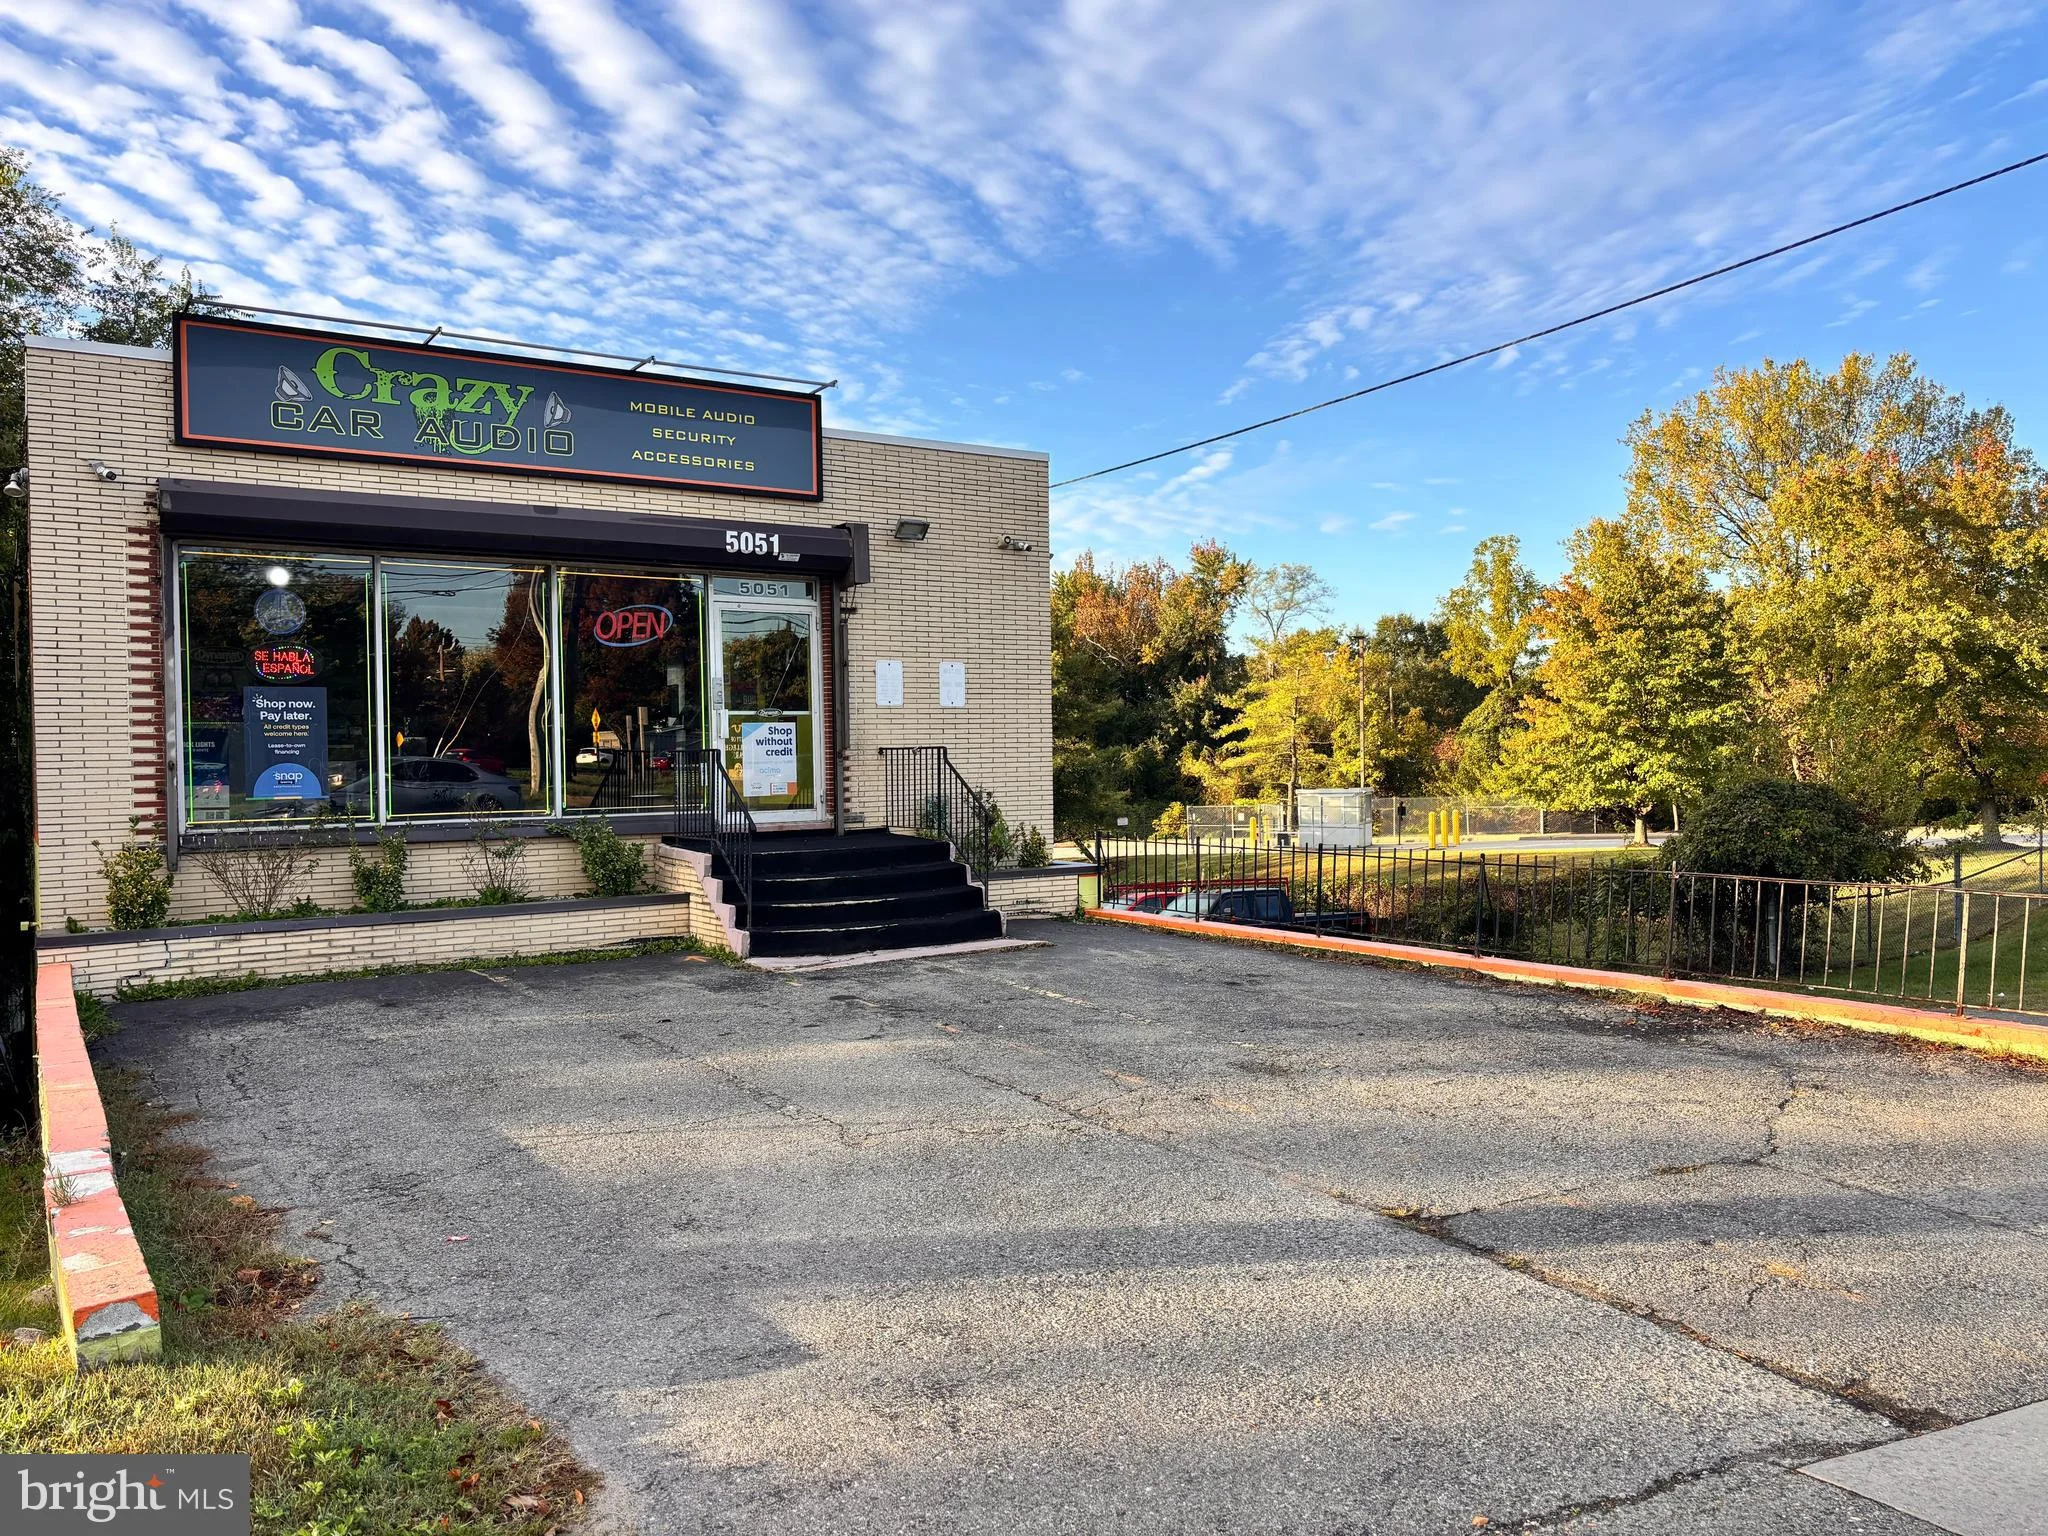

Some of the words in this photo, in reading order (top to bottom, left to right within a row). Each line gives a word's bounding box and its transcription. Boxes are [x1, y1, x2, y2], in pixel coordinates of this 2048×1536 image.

[312, 347, 534, 455] Crazy
[630, 401, 696, 418] MOBILE
[702, 410, 755, 425] AUDIO
[271, 401, 383, 439] CAR
[414, 417, 574, 456] AUDIO
[652, 428, 736, 446] SECURITY
[631, 450, 755, 471] ACCESSORIES
[725, 530, 779, 556] 5051
[740, 582, 789, 597] 5051
[596, 611, 666, 640] OPEN
[254, 650, 269, 661] SE
[273, 651, 311, 662] HABLA
[262, 662, 314, 674] ESPAÑOL
[255, 698, 286, 710] Shop
[288, 700, 316, 709] now.
[260, 711, 281, 722] Pay
[283, 711, 312, 721] later.
[768, 726, 793, 737] Shop
[755, 737, 793, 746] without
[765, 747, 793, 757] credit
[274, 772, 303, 783] snap
